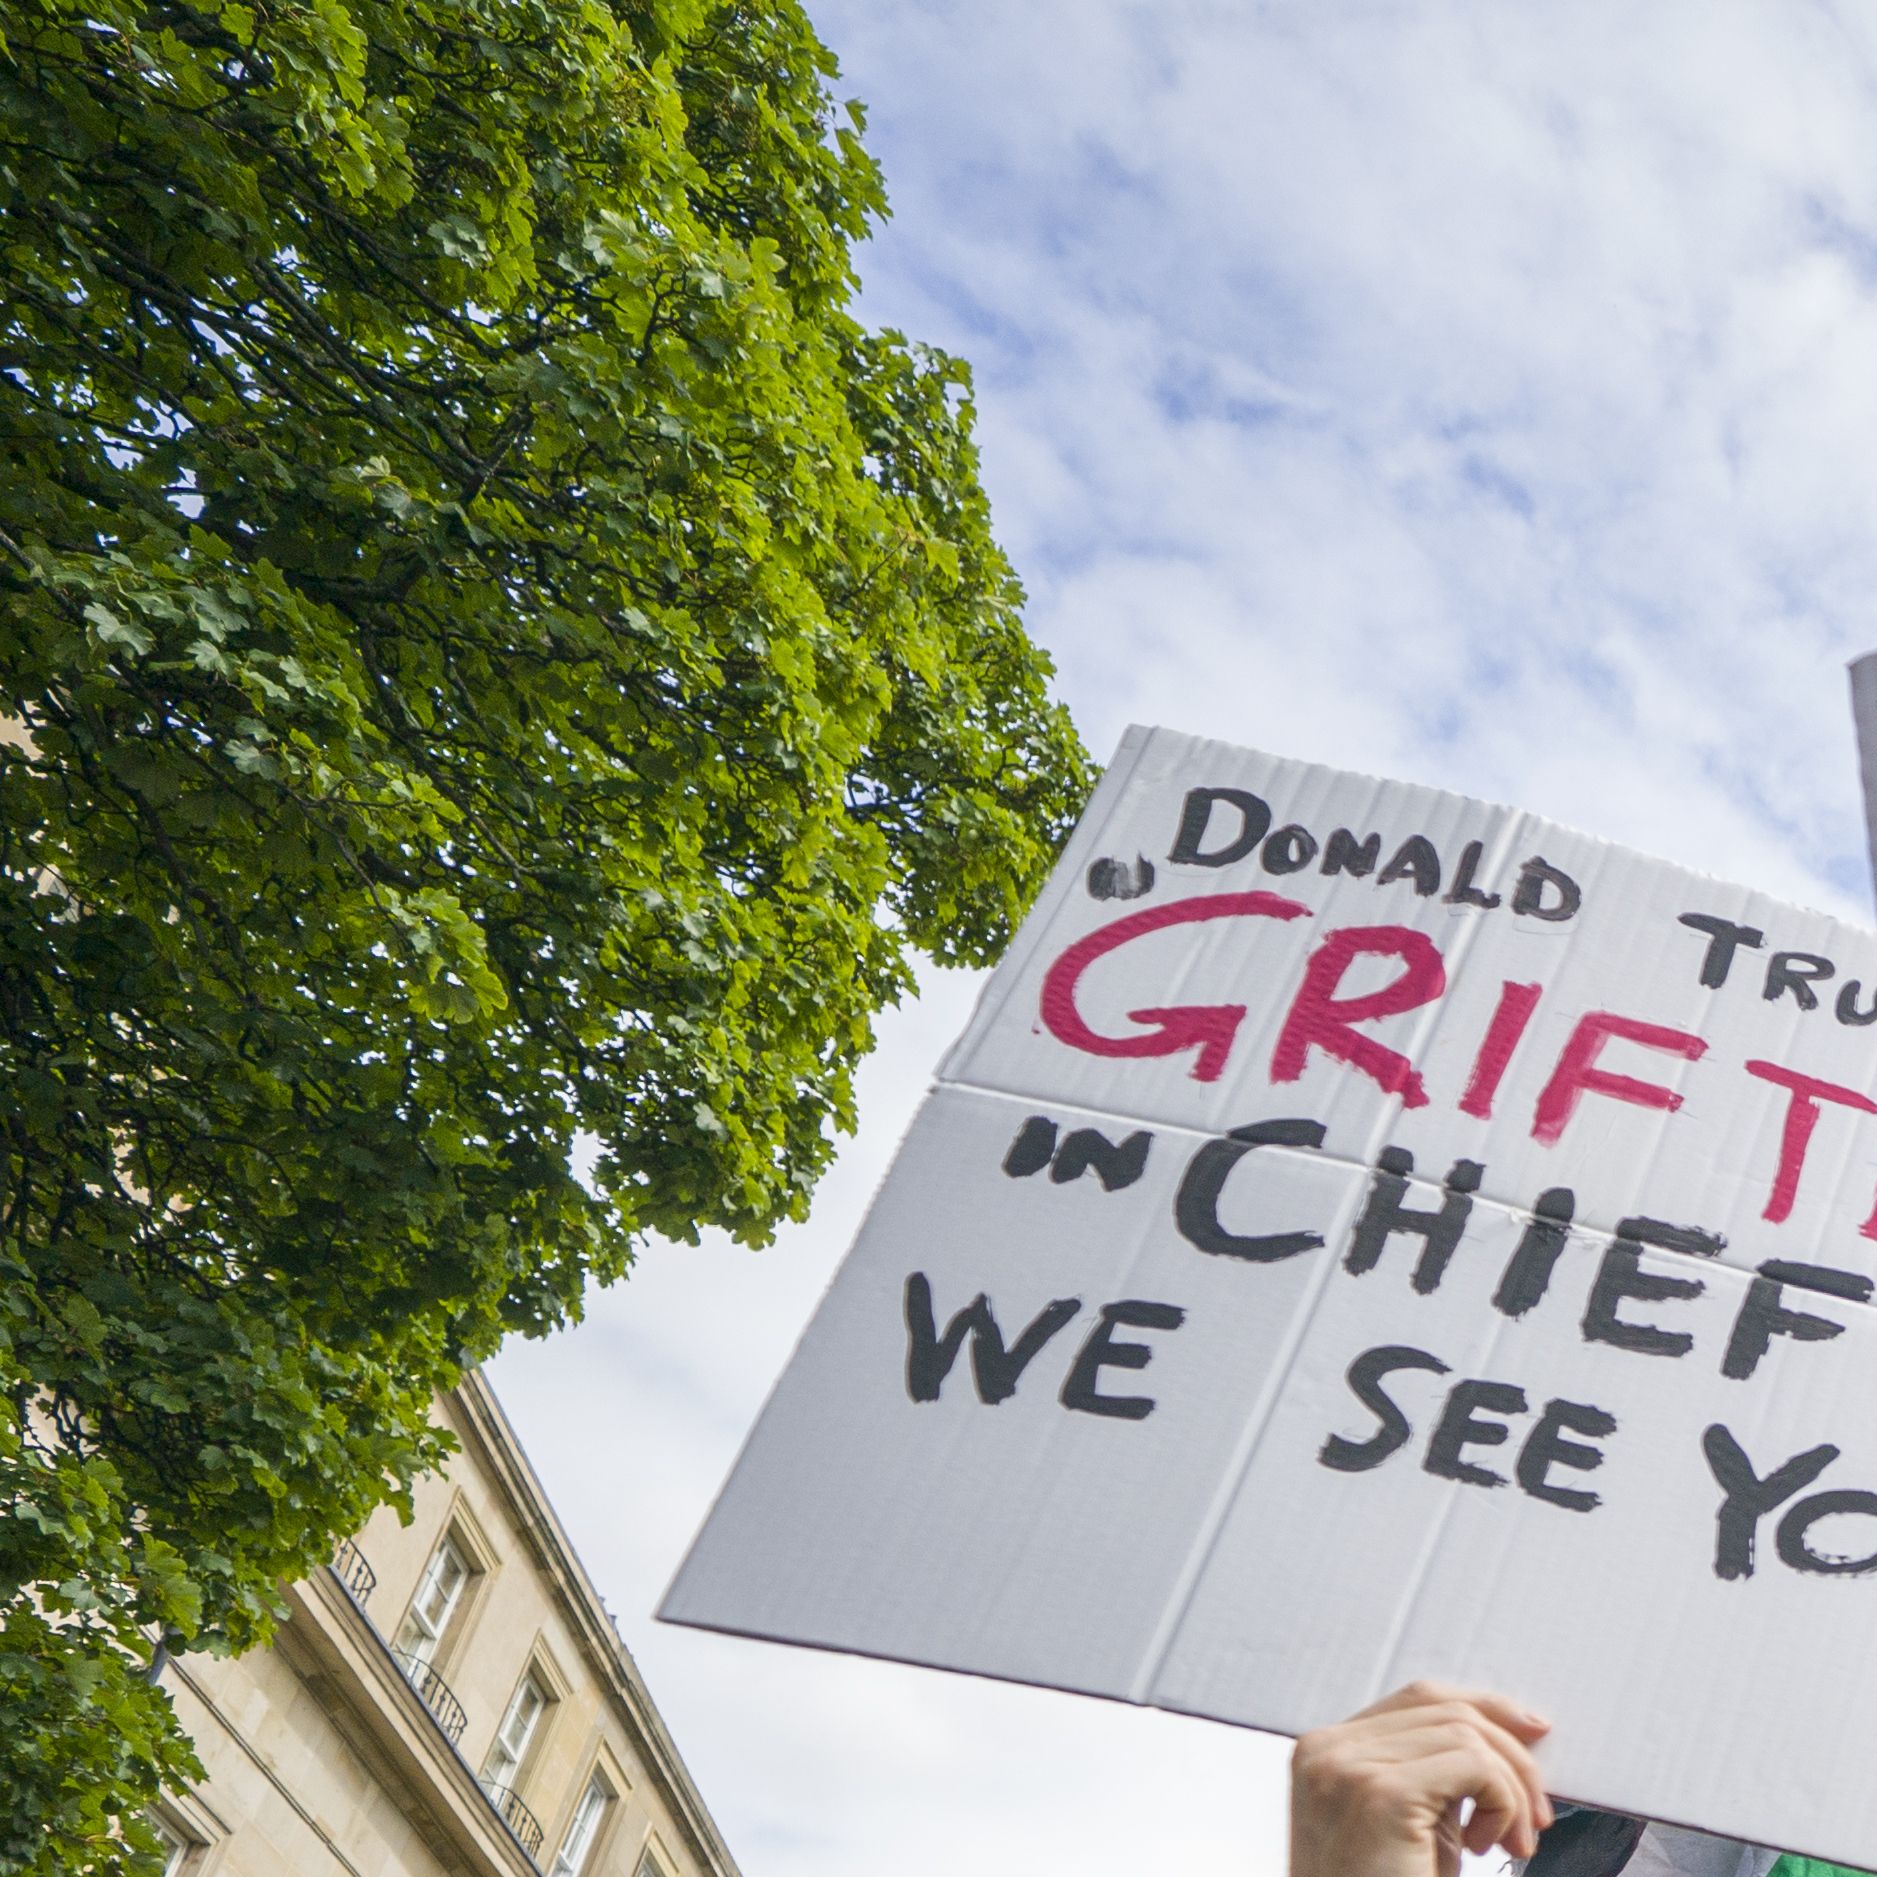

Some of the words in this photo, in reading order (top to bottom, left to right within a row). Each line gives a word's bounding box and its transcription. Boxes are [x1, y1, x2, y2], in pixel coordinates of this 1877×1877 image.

[1167, 786, 1581, 921] DONALD
[1001, 1116, 1153, 1191] IN
[1173, 1118, 1876, 1379] CHIEF
[901, 1271, 1187, 1421] WE
[1318, 1344, 1618, 1513] SEE
